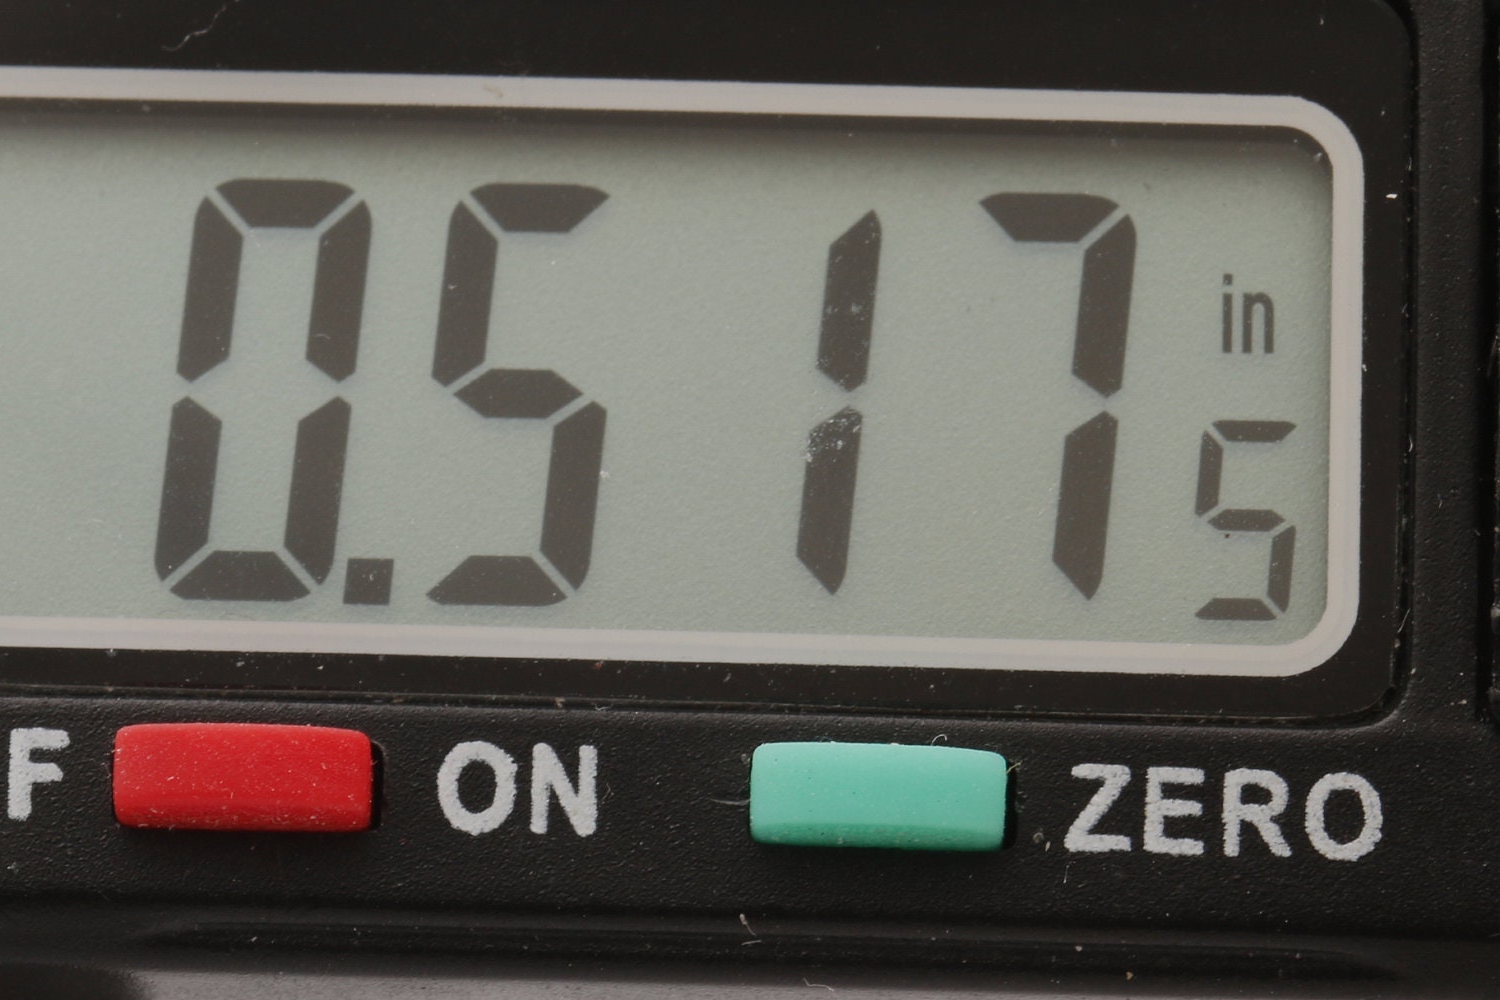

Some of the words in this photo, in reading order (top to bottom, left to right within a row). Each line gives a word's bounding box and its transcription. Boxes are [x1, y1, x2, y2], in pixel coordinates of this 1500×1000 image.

[1221, 273, 1276, 354] in
[436, 739, 598, 837] ON
[1064, 763, 1384, 862] ZERO
